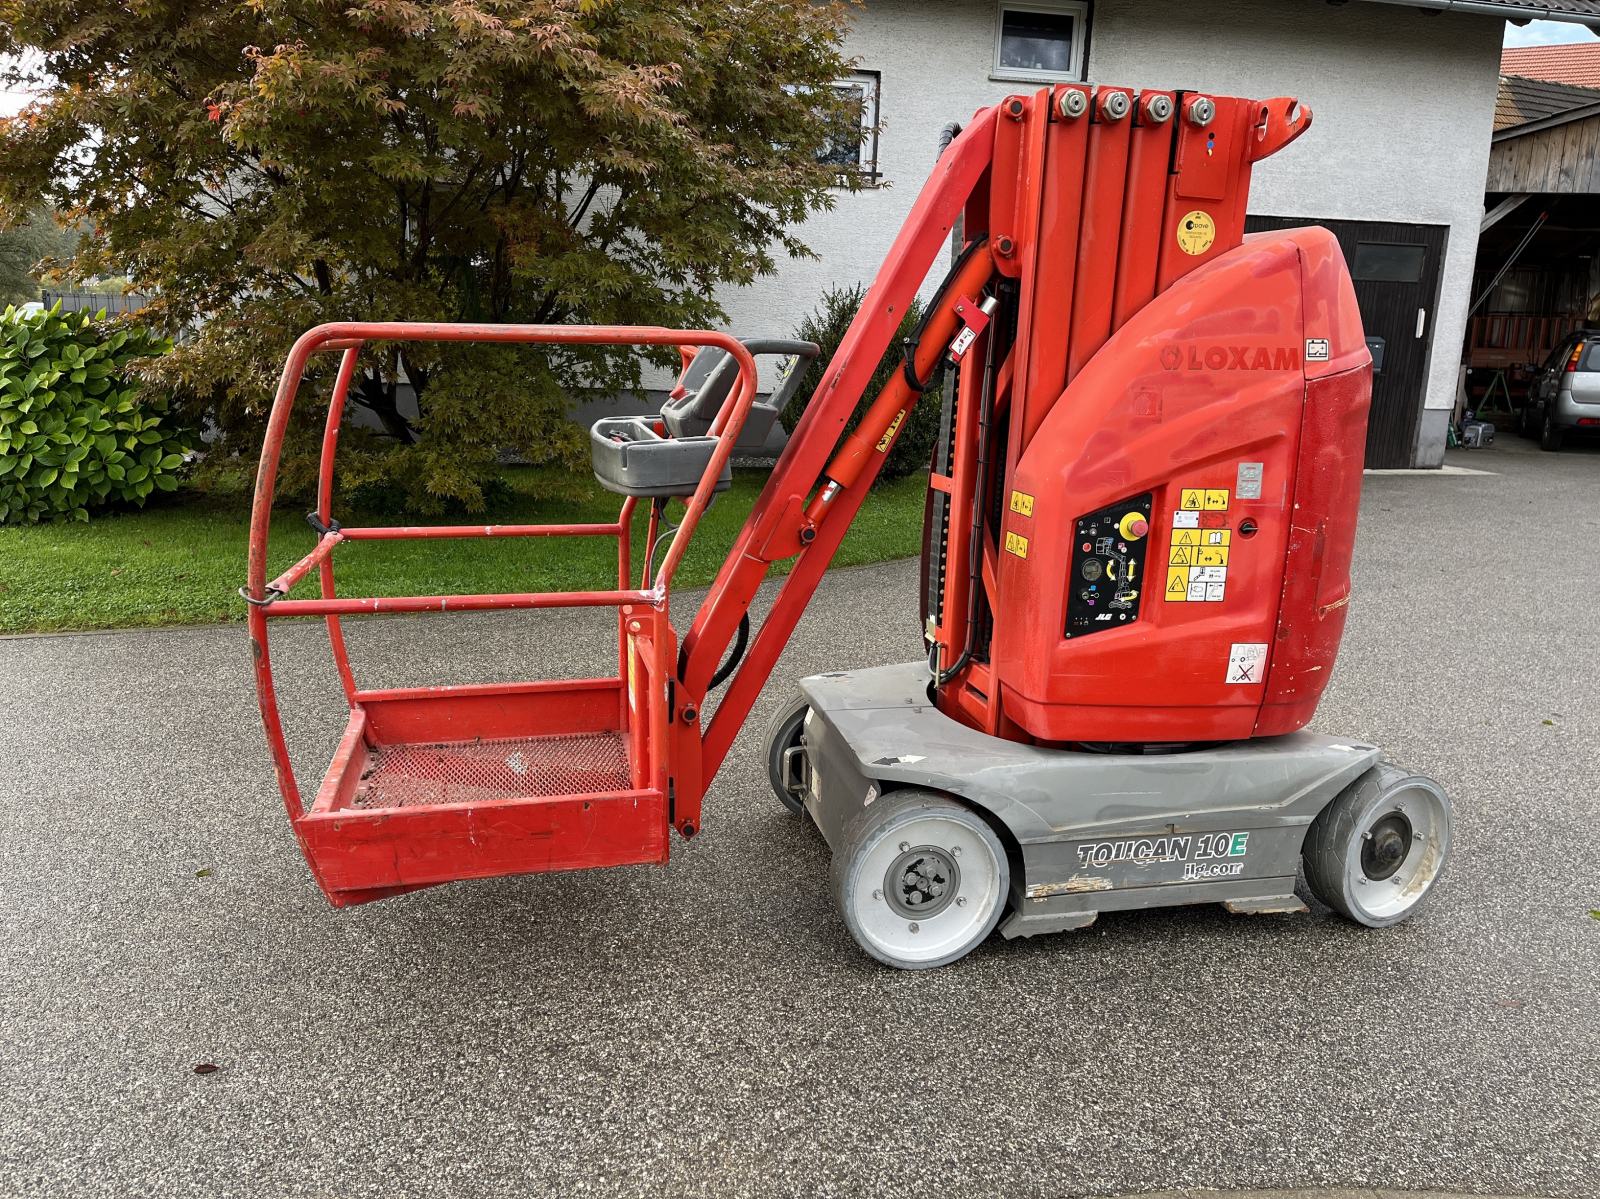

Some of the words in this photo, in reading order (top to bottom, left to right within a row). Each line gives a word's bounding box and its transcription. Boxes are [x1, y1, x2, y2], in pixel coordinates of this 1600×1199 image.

[1188, 345, 1300, 371] LOXAM
[1077, 837, 1191, 868] TOUCAN
[1195, 832, 1249, 859] 10E
